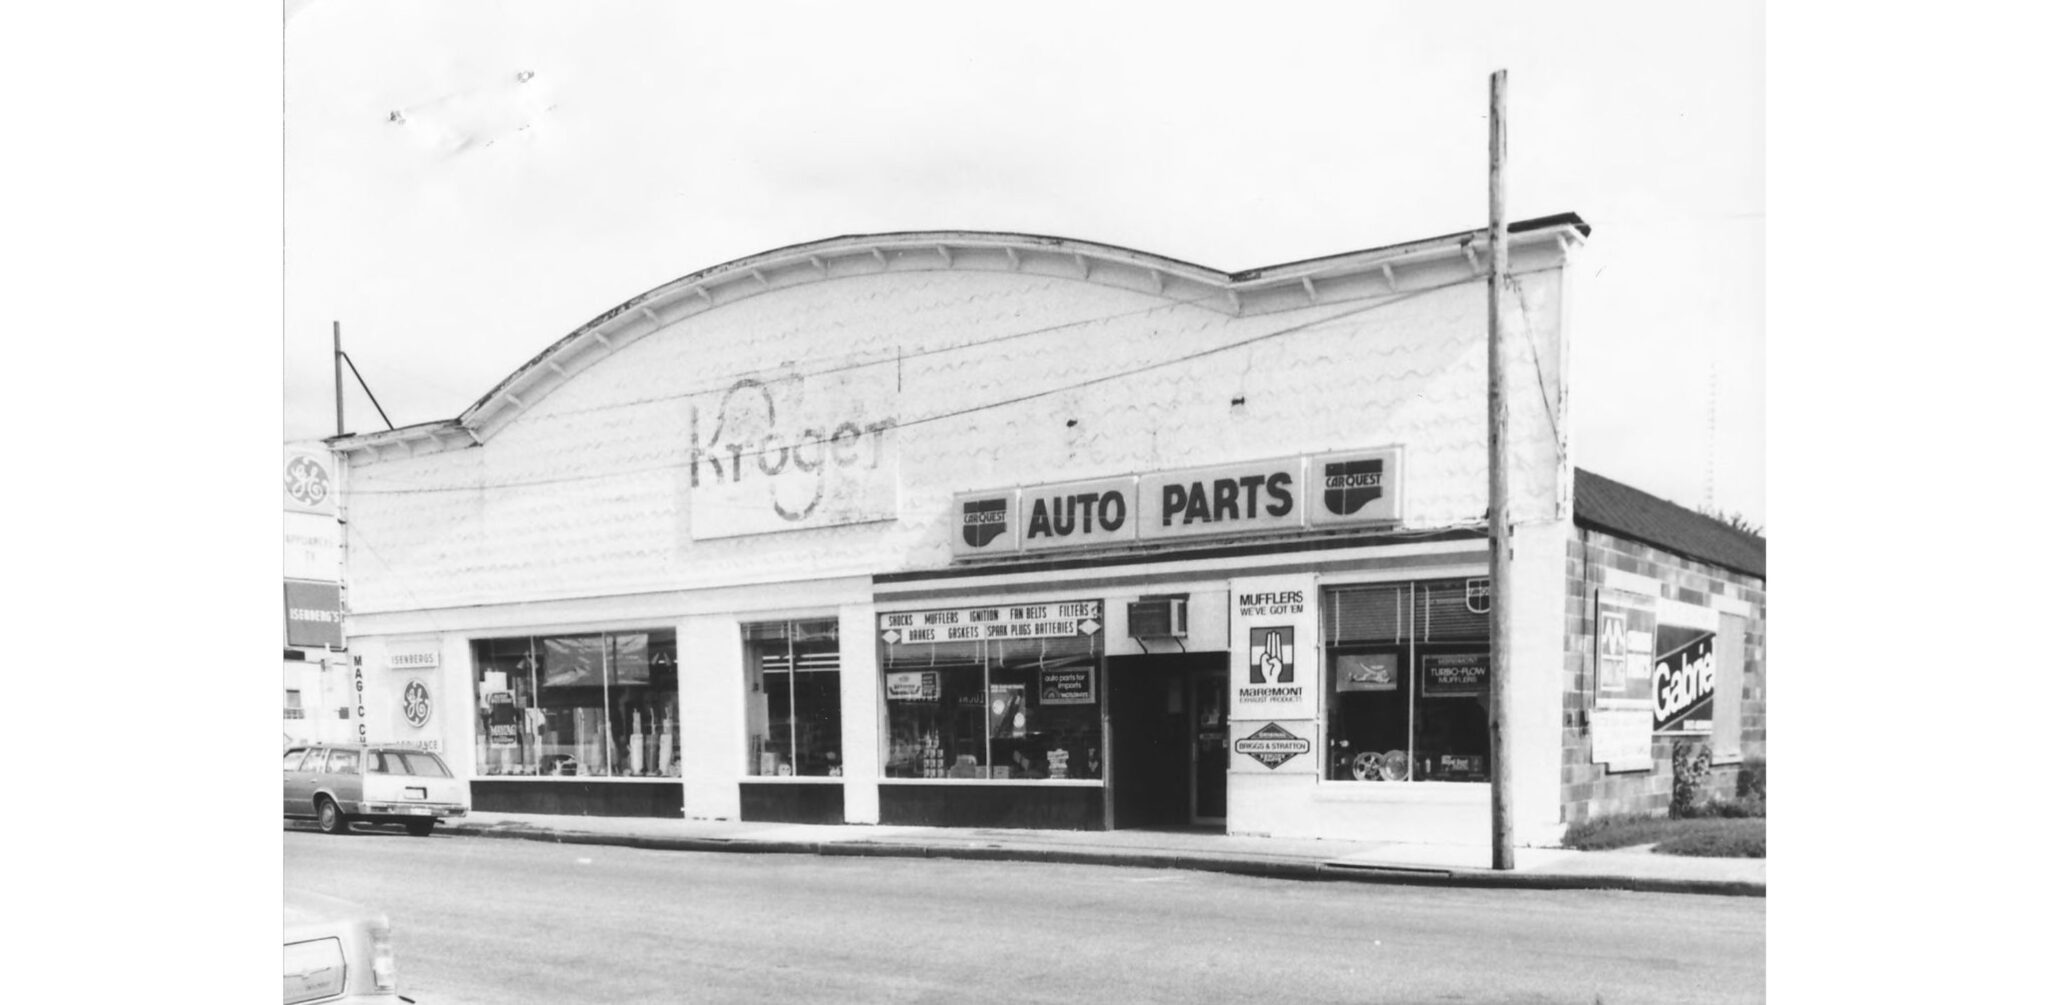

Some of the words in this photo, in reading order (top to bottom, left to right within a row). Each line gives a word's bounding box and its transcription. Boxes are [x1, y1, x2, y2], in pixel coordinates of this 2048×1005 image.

[690, 379, 897, 521] Kroger
[1027, 490, 1126, 539] AUTO
[1162, 472, 1293, 526] PARTS
[1240, 590, 1303, 606] MUFFLERS
[889, 614, 913, 627] SHOCKS
[925, 611, 959, 625] MUFFLERS
[969, 608, 999, 622] IGNITION
[1010, 608, 1024, 620] FAN
[1026, 606, 1047, 619] BELTS
[1059, 604, 1088, 617] FILTERS
[1240, 606, 1267, 616] WE'VE
[1269, 605, 1287, 615] GOT
[909, 628, 935, 641] BRAKES
[948, 626, 979, 639] GASKETS
[987, 625, 1008, 637] SPARK
[1010, 624, 1031, 636] PLUGS
[1035, 621, 1073, 635] BATTERIES
[1045, 674, 1058, 682] auto
[1059, 674, 1075, 682] parts
[1431, 666, 1486, 676] TURBO-FLOW
[1654, 636, 1716, 722] Gabriel
[354, 655, 365, 717] MAGIC
[1057, 682, 1081, 690] imports
